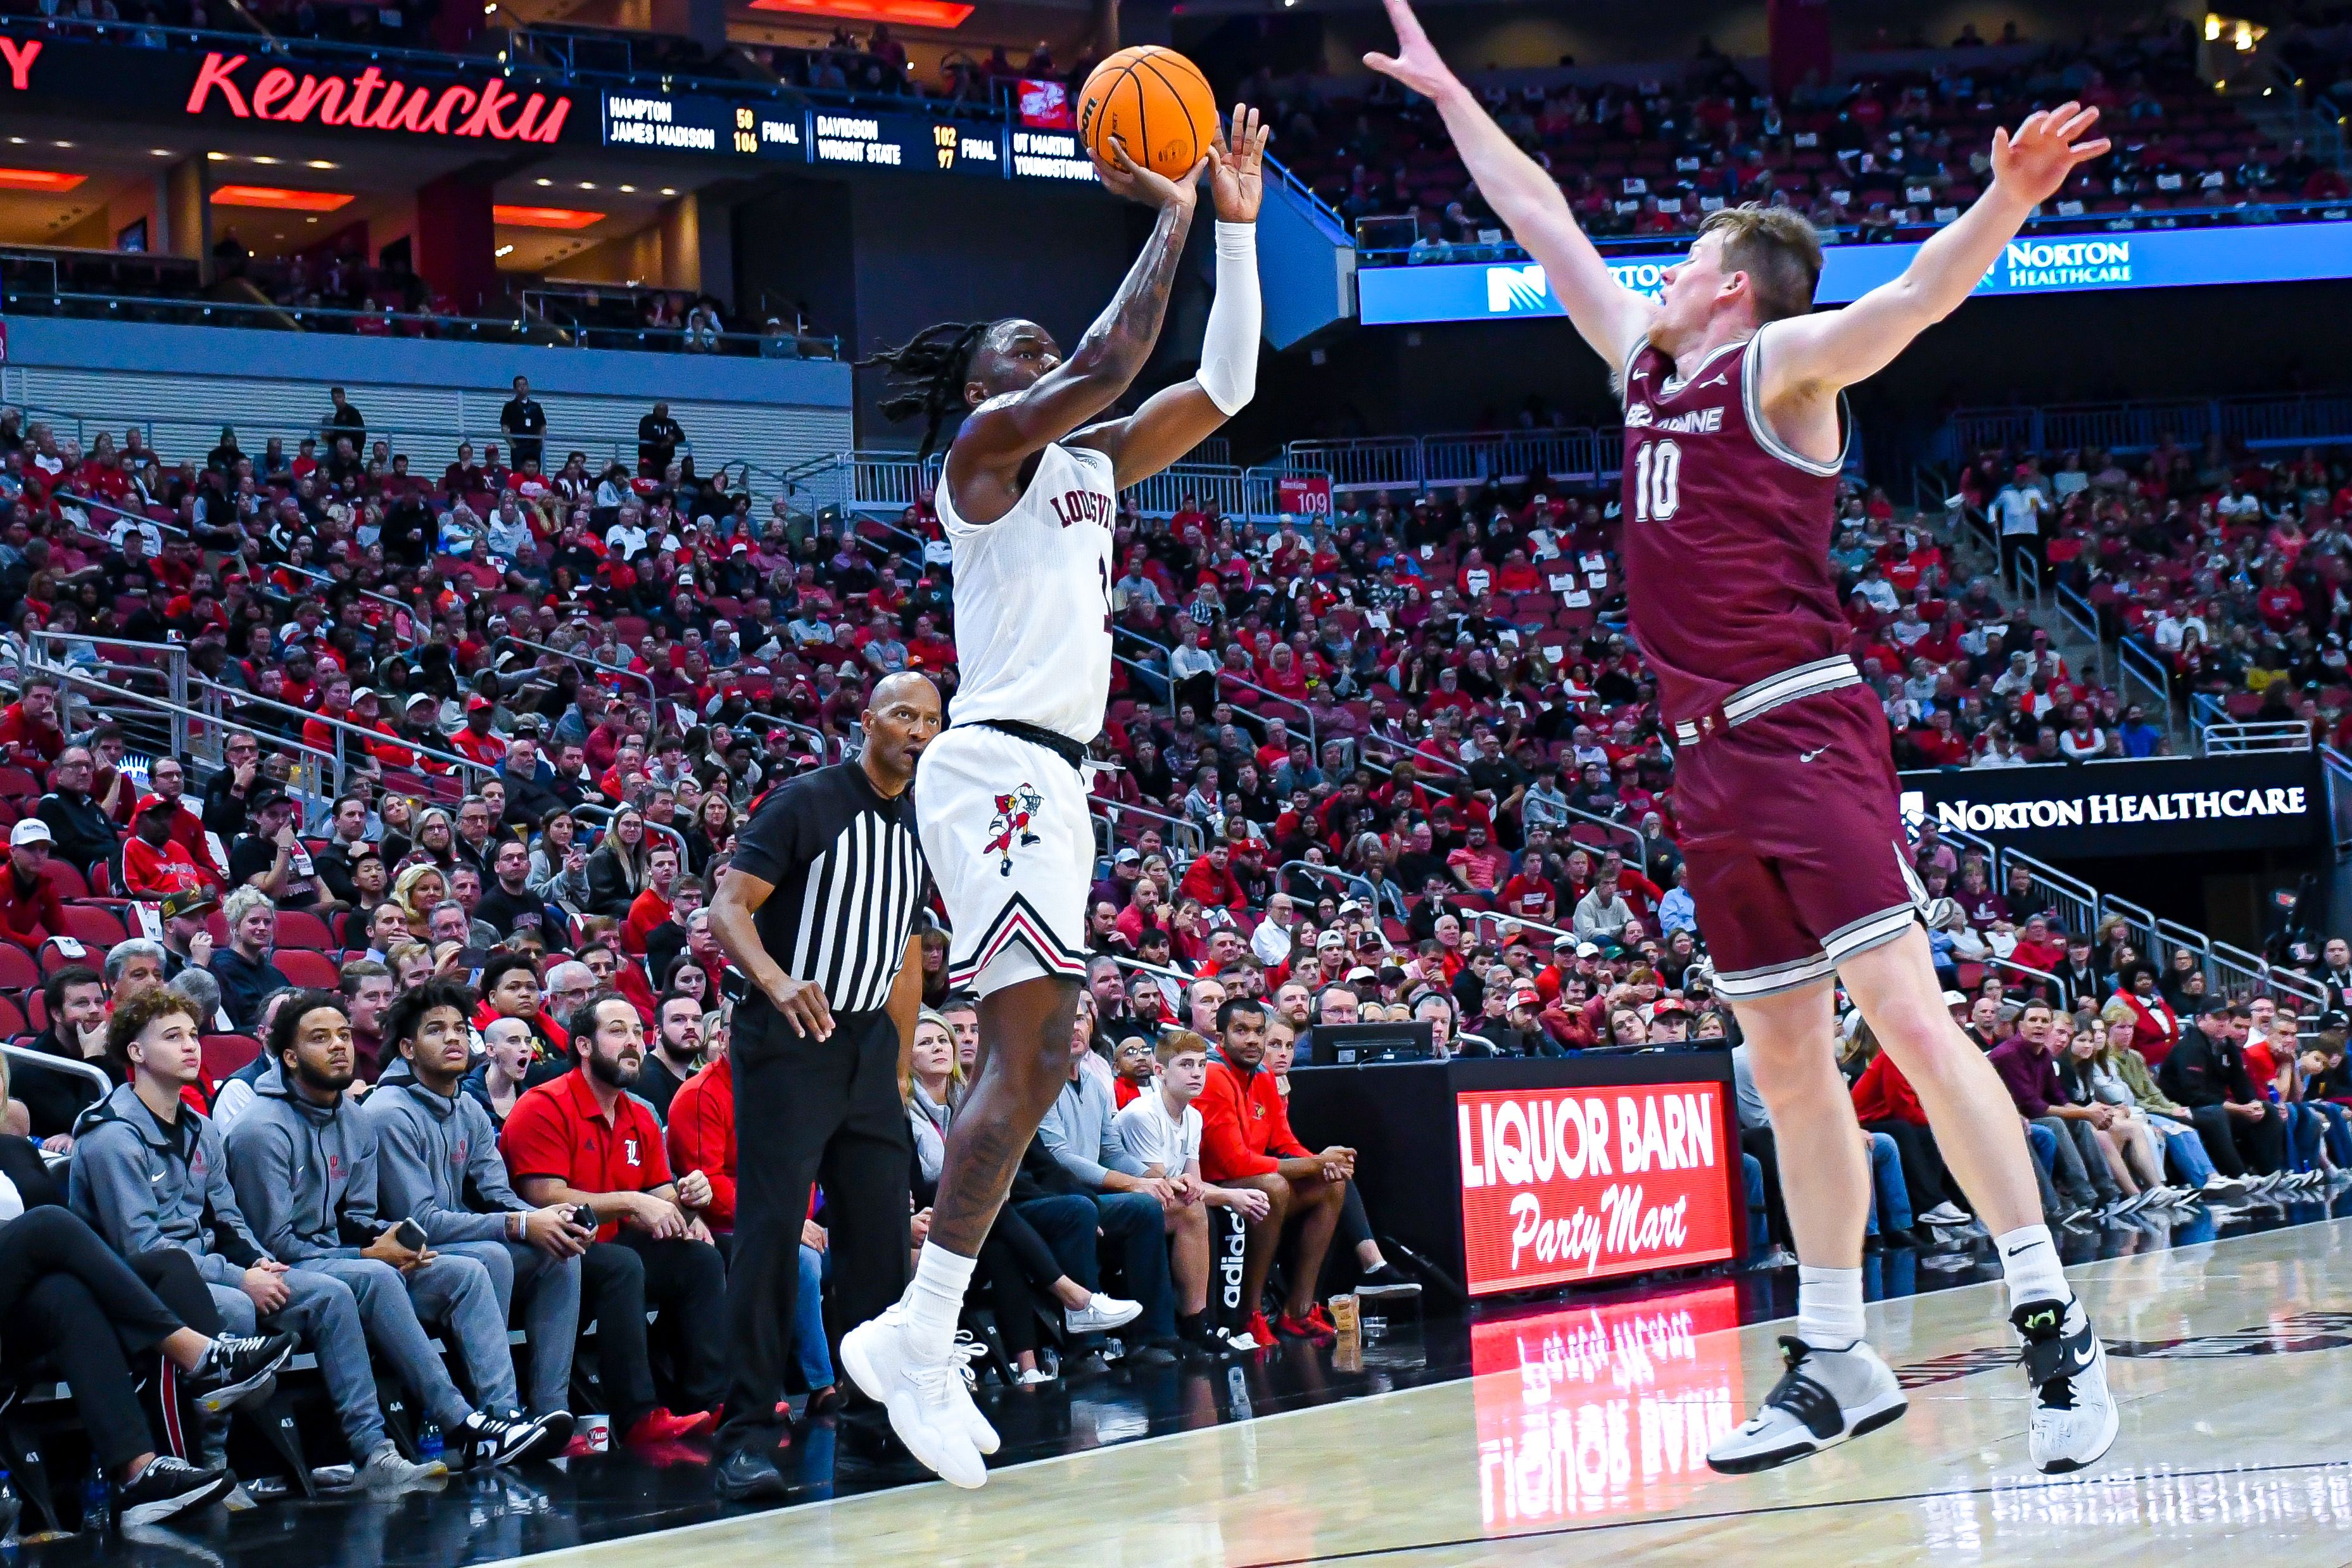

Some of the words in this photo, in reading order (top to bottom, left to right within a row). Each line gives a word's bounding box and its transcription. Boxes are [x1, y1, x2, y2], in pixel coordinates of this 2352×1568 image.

[186, 52, 570, 143] Kentucky
[610, 97, 672, 122] HAMPTON
[610, 121, 654, 144] JAMES
[656, 125, 715, 149] MADISON
[733, 131, 757, 153] 106
[762, 122, 799, 144] FINAL
[817, 116, 878, 141] DAVIDSON
[933, 126, 957, 147] 102
[1013, 133, 1029, 153] UT
[1030, 134, 1075, 157] MARTIN
[818, 139, 865, 162] WRIGHT
[866, 143, 901, 165] STATE
[938, 149, 954, 168] 97
[961, 138, 997, 161] FINAL
[1014, 155, 1094, 180] YOUNGSTOWN
[2006, 240, 2129, 269] NORTON
[2009, 265, 2133, 288] HEALTHCARE
[1634, 439, 1681, 522] 10
[1298, 493, 1327, 514] 109
[1936, 799, 2083, 833] NORTON
[2088, 787, 2306, 823] HEALTHCARE
[1458, 1097, 1614, 1188] LIQUOR
[1617, 1093, 1714, 1174] BARN
[1509, 1192, 1602, 1275] Party
[1600, 1182, 1687, 1255] Mart
[1220, 1205, 1246, 1309] adida
